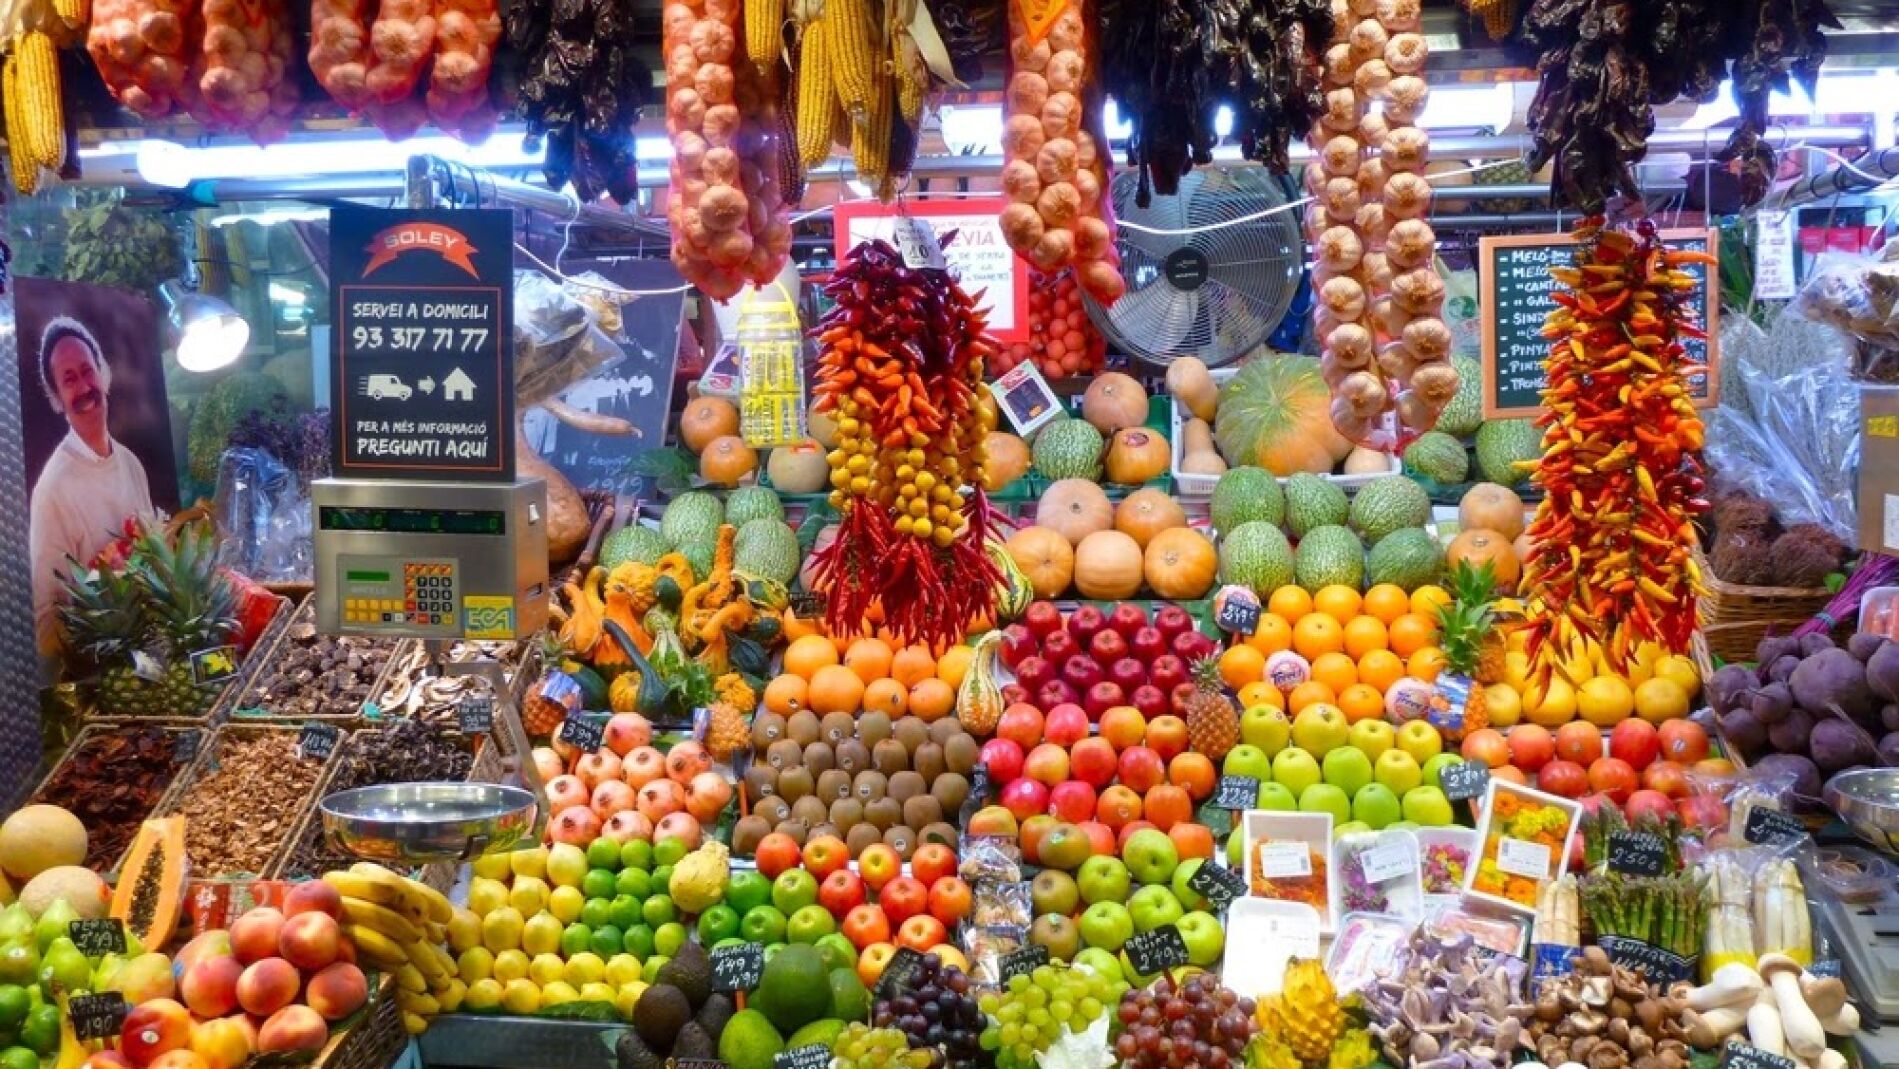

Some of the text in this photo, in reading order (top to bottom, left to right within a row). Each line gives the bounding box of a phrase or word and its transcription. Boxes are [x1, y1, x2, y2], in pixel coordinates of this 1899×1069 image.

[384, 231, 460, 248] SOLEY
[352, 303, 489, 321] SERVEI A DOMICILI
[352, 326, 489, 352] 93 317 71 77
[357, 419, 487, 435] PER A MÉS INFORMACIÓ
[356, 435, 488, 458] PREGUNTI AQUÍ
